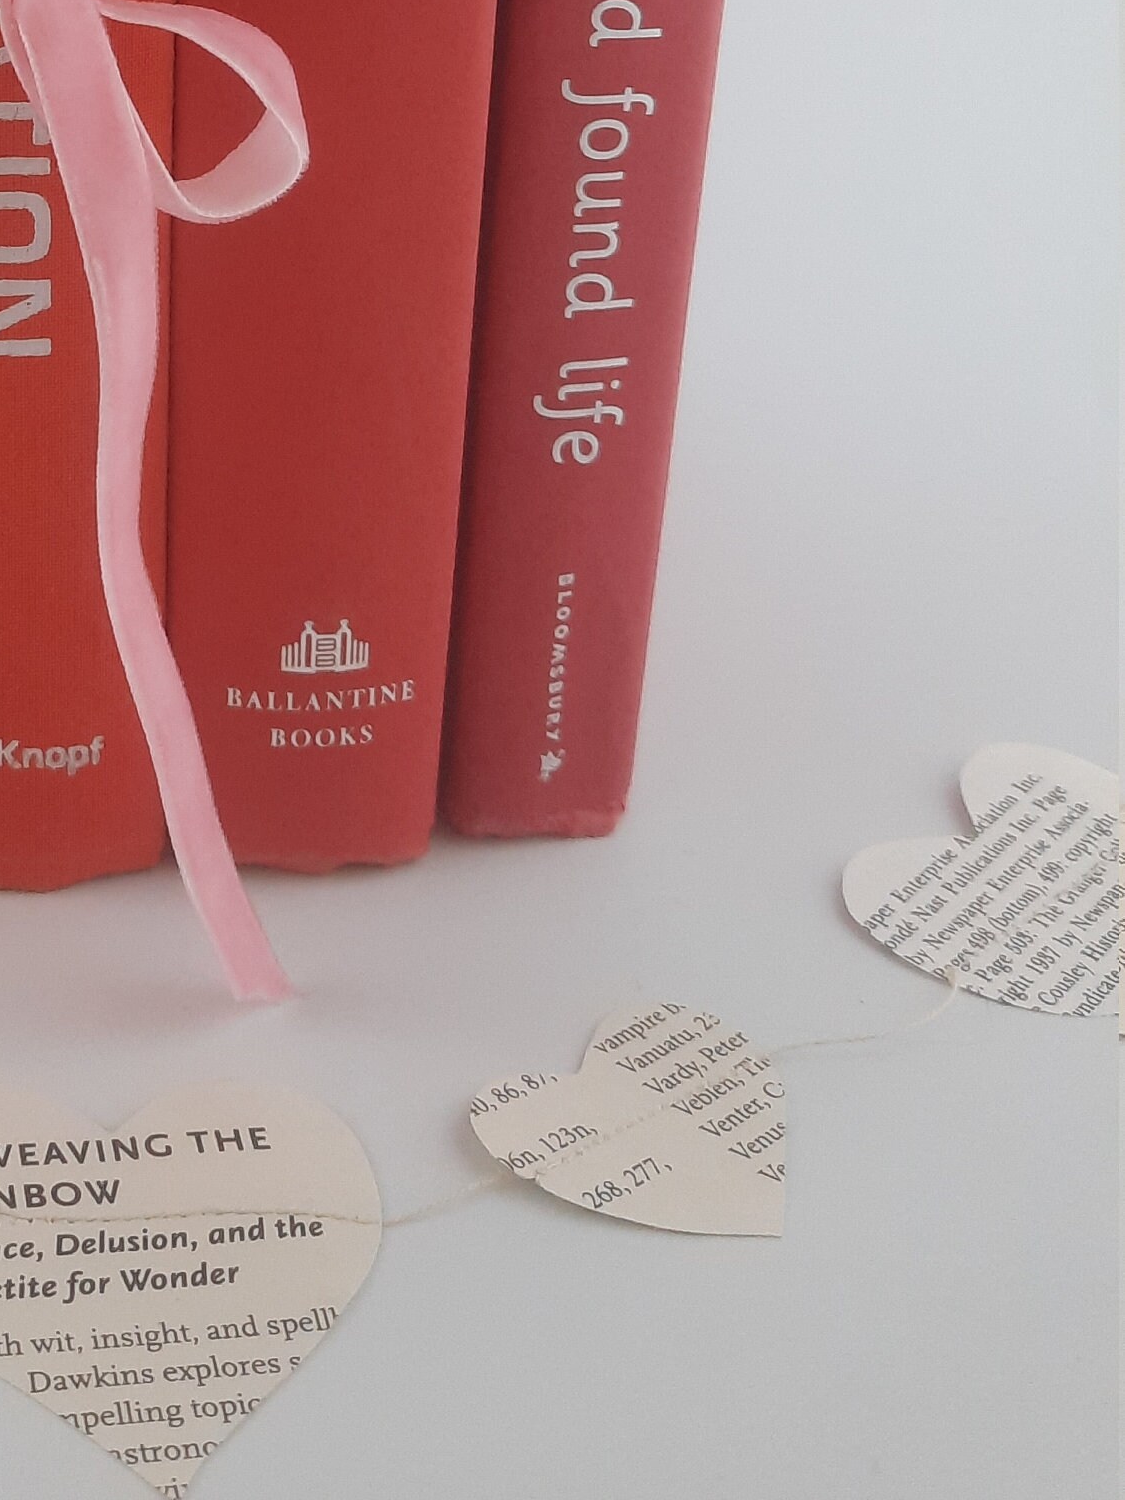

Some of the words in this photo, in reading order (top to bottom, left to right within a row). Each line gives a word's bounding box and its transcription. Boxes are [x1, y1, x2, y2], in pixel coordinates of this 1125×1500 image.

[561, 78, 655, 318] found
[533, 356, 628, 466] life
[546, 573, 574, 740] BLOOMSBURY
[227, 679, 415, 711] BALLANTINE
[270, 724, 373, 748] BOOKS
[889, 847, 958, 903] Enterprise
[1011, 773, 1043, 794] Inc.
[910, 895, 949, 923] Nast
[941, 831, 1018, 896] Publications
[1009, 812, 1040, 833] Inc.
[1032, 784, 1067, 812] Page
[922, 892, 994, 950] Newspaper
[986, 839, 1051, 893] Enterprise
[967, 927, 995, 949] 498
[988, 883, 1049, 932] (bottom),
[1065, 813, 1118, 862] copyright
[974, 954, 1013, 982] Page
[1025, 945, 1061, 975] 1987
[1052, 930, 1083, 947] by
[1037, 961, 1095, 1006] Cousley
[593, 1010, 666, 1053] vampire
[616, 1027, 702, 1073] Vanuatu,
[642, 1060, 708, 1094] Vardy,
[698, 1031, 749, 1064] Peter
[491, 1082, 528, 1103] 86,
[671, 1078, 746, 1116] Veblen,
[539, 1125, 598, 1153] 123n,
[698, 1097, 772, 1138] Venter,
[186, 1126, 272, 1155] THE
[582, 1181, 632, 1210] 268,
[623, 1157, 673, 1187] 277,
[56, 1227, 198, 1258] Delusion,
[209, 1216, 266, 1246] and
[274, 1214, 324, 1240] the
[64, 1270, 111, 1304] for
[121, 1261, 239, 1293] Wonder
[30, 1330, 83, 1356] wit,
[91, 1321, 199, 1352] insight,
[206, 1314, 261, 1341] and
[27, 1364, 154, 1394] Dawkins
[163, 1355, 281, 1387] explores
